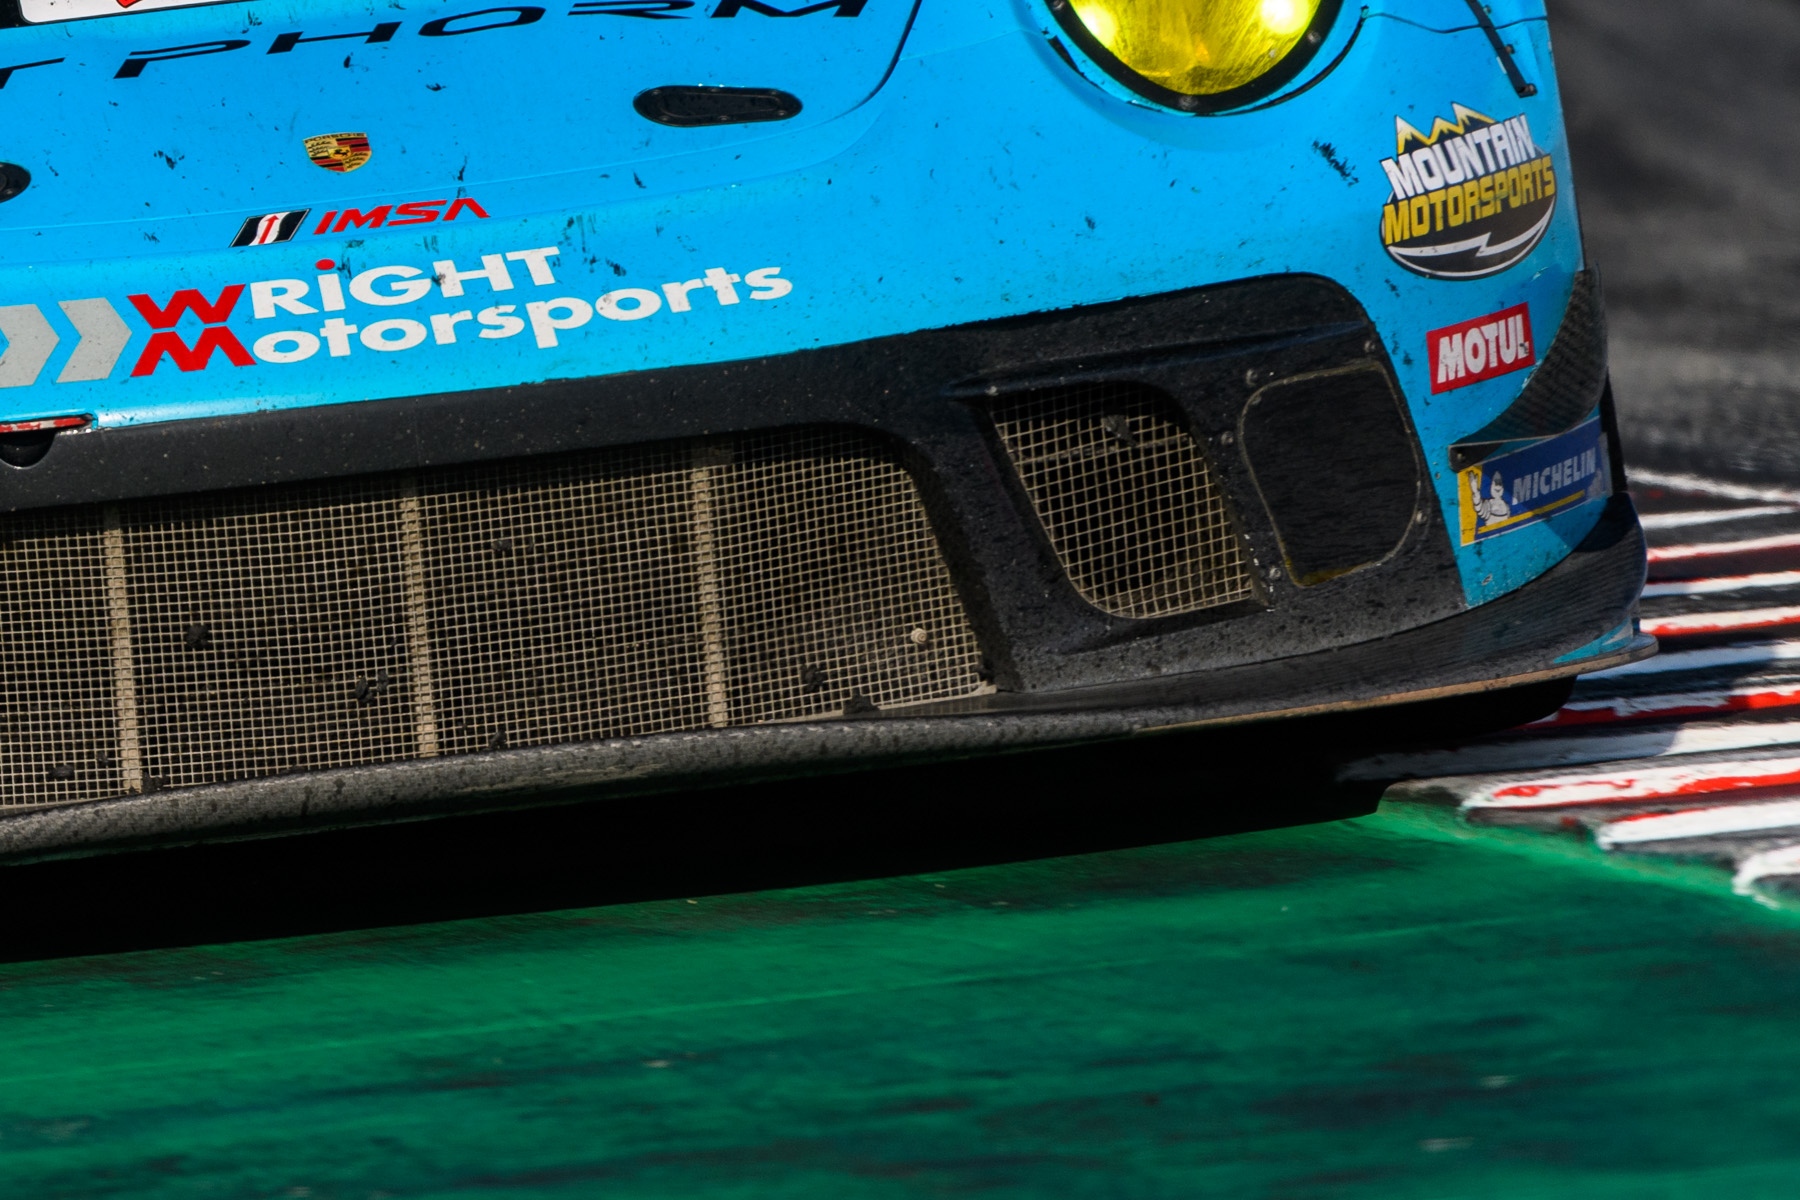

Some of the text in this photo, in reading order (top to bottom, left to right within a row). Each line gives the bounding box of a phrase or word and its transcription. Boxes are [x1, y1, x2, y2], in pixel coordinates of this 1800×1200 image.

[1381, 113, 1538, 200] MOUNTAIN
[313, 197, 492, 235] IMSA
[1382, 152, 1557, 247] MOTORSPORTS
[129, 263, 793, 378] Motorsports
[1435, 312, 1531, 386] MOTUL
[1511, 445, 1598, 506] MICHELIN
